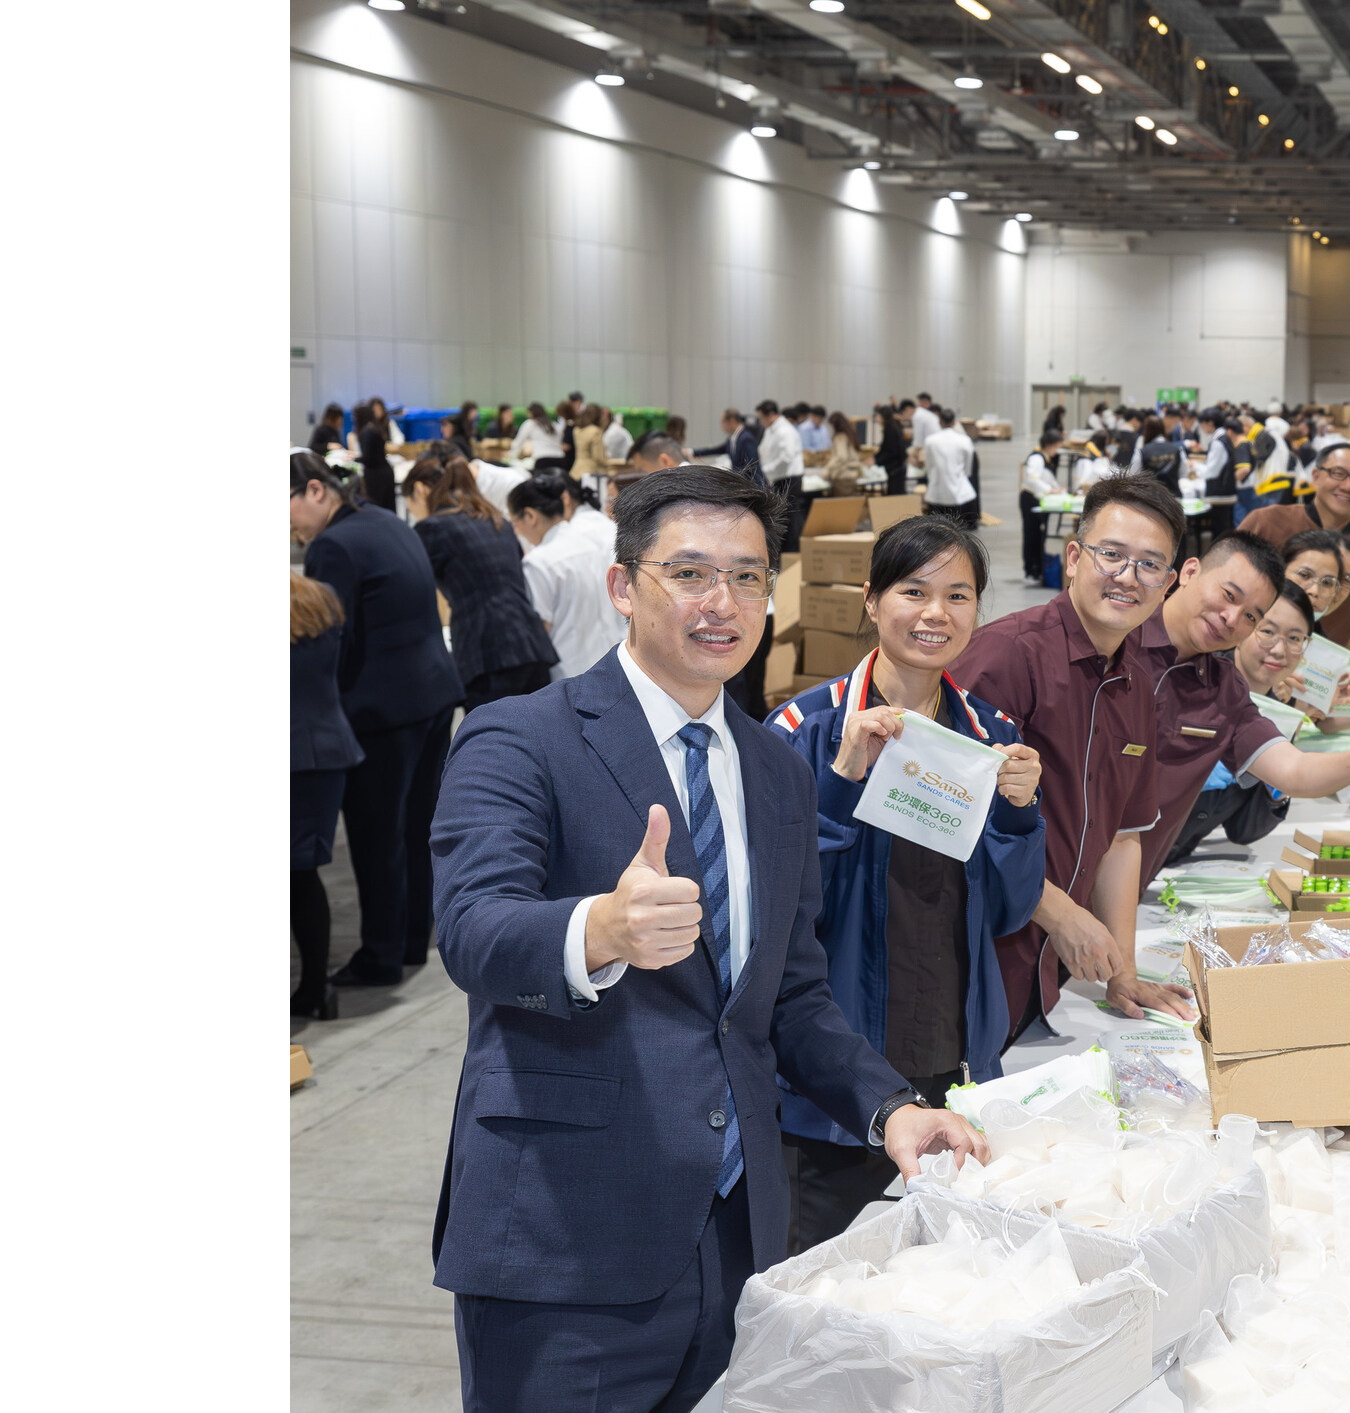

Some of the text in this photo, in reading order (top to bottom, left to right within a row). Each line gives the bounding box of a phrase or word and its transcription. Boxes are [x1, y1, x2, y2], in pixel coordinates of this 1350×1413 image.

[916, 781, 971, 811] SANDS CARES
[921, 771, 976, 803] Sands
[883, 801, 915, 819] SANDS
[887, 788, 962, 828] 金沙環保360
